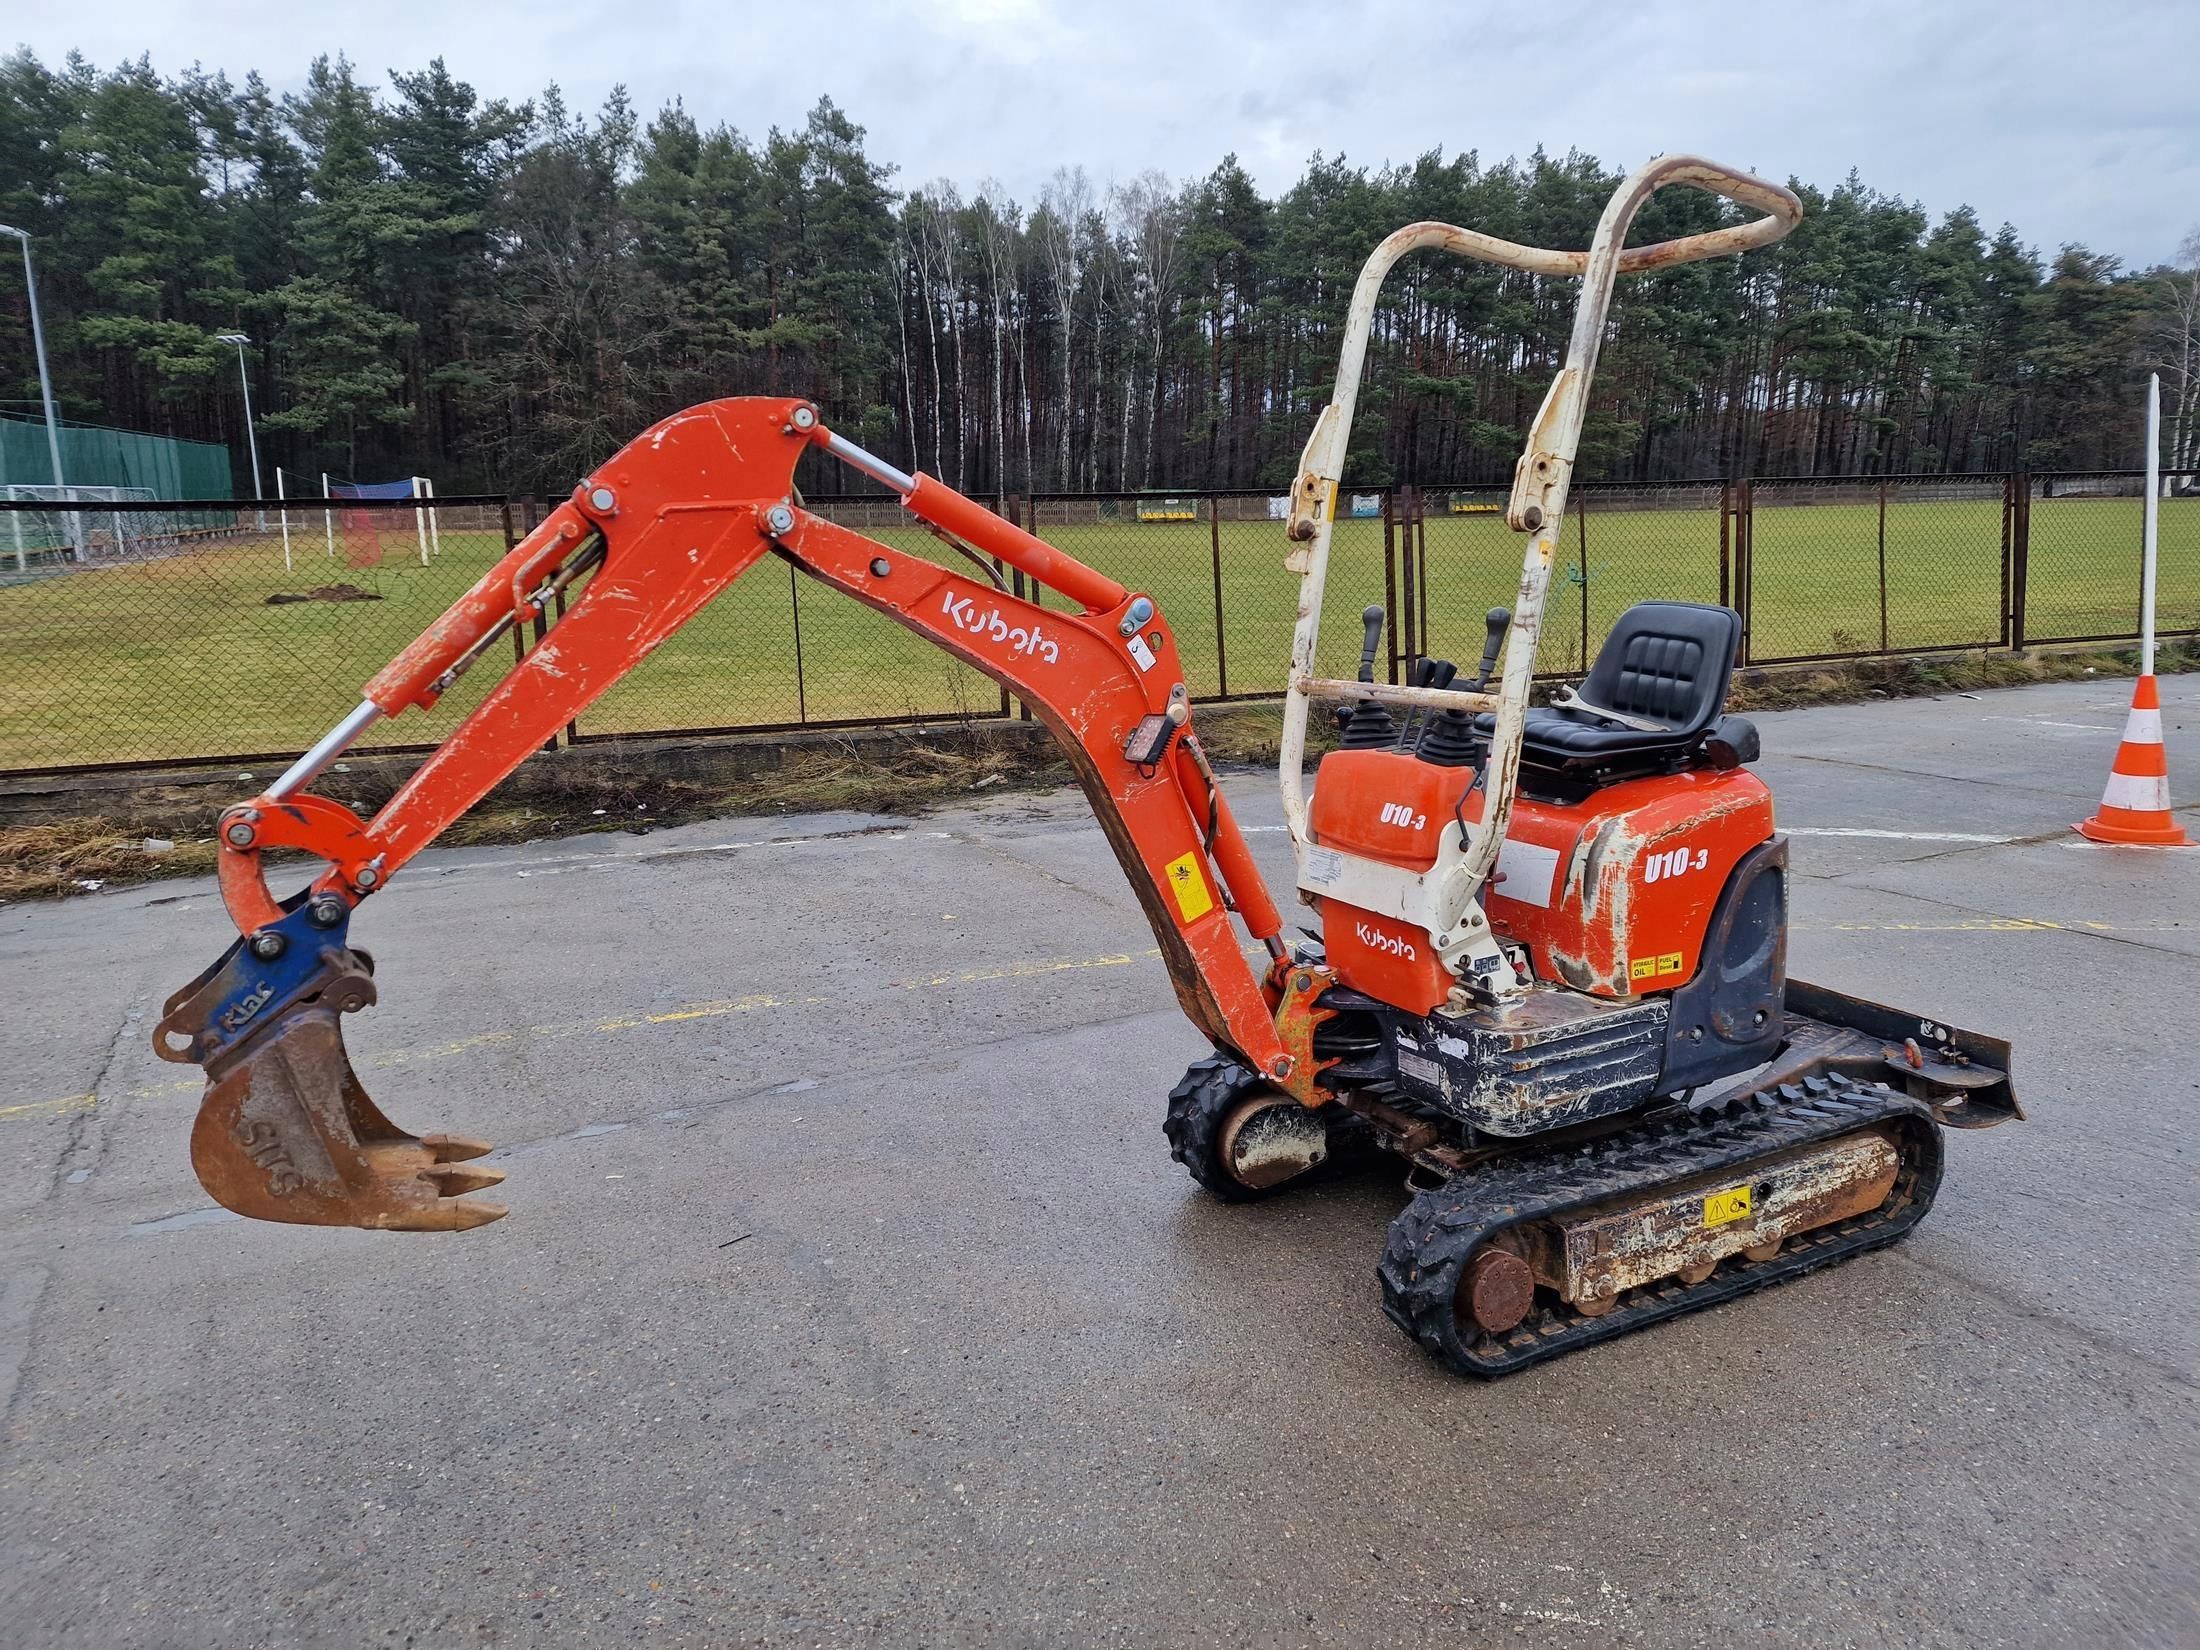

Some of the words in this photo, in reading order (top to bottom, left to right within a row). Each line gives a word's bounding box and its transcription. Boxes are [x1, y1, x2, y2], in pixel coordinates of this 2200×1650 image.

[942, 591, 1059, 664] Kubota
[1380, 802, 1427, 830] U10-3
[1644, 847, 1709, 883] U10-3
[1356, 921, 1415, 961] Kubota
[1634, 968, 1645, 976] OIL
